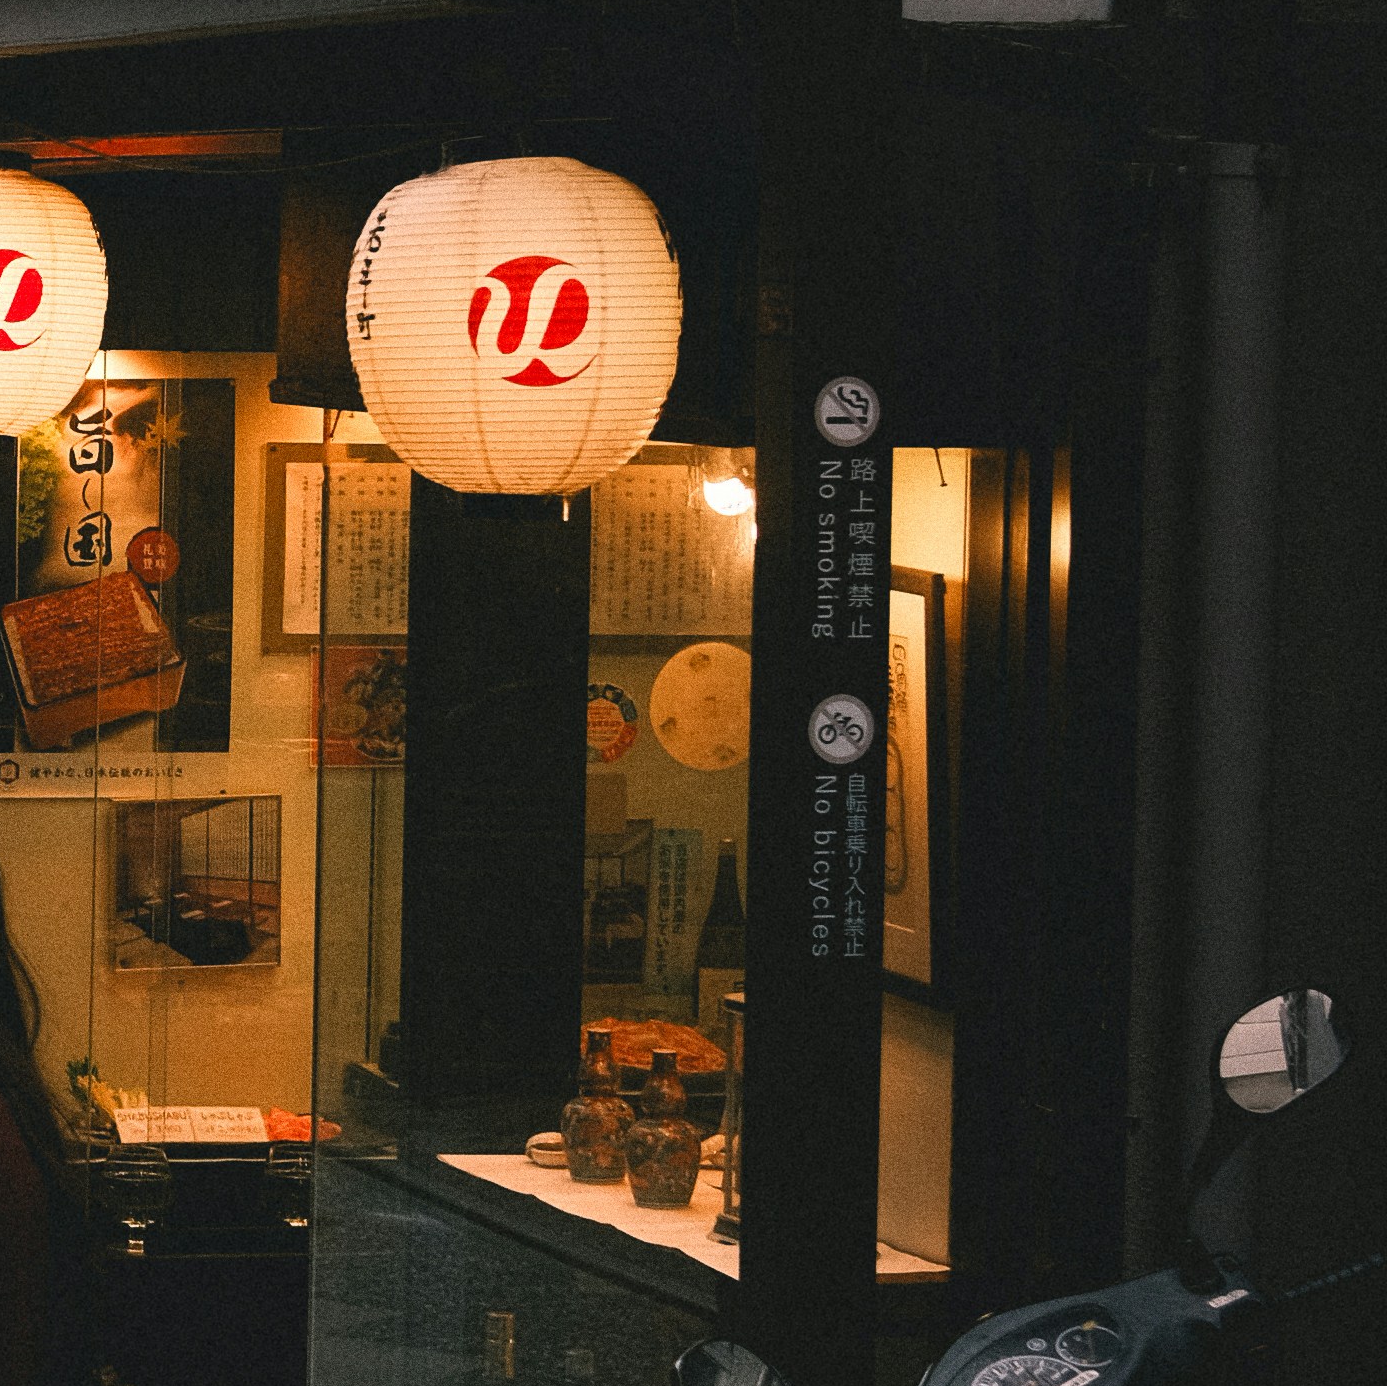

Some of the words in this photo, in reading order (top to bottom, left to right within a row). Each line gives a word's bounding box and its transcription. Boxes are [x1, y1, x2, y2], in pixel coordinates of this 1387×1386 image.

[819, 460, 843, 499] No
[811, 512, 843, 639] smoking
[847, 457, 877, 638] 路上喫煙禁止
[814, 775, 837, 814] No
[808, 830, 838, 957] bicycles
[843, 772, 869, 957] 自転車乗り入れ禁止
